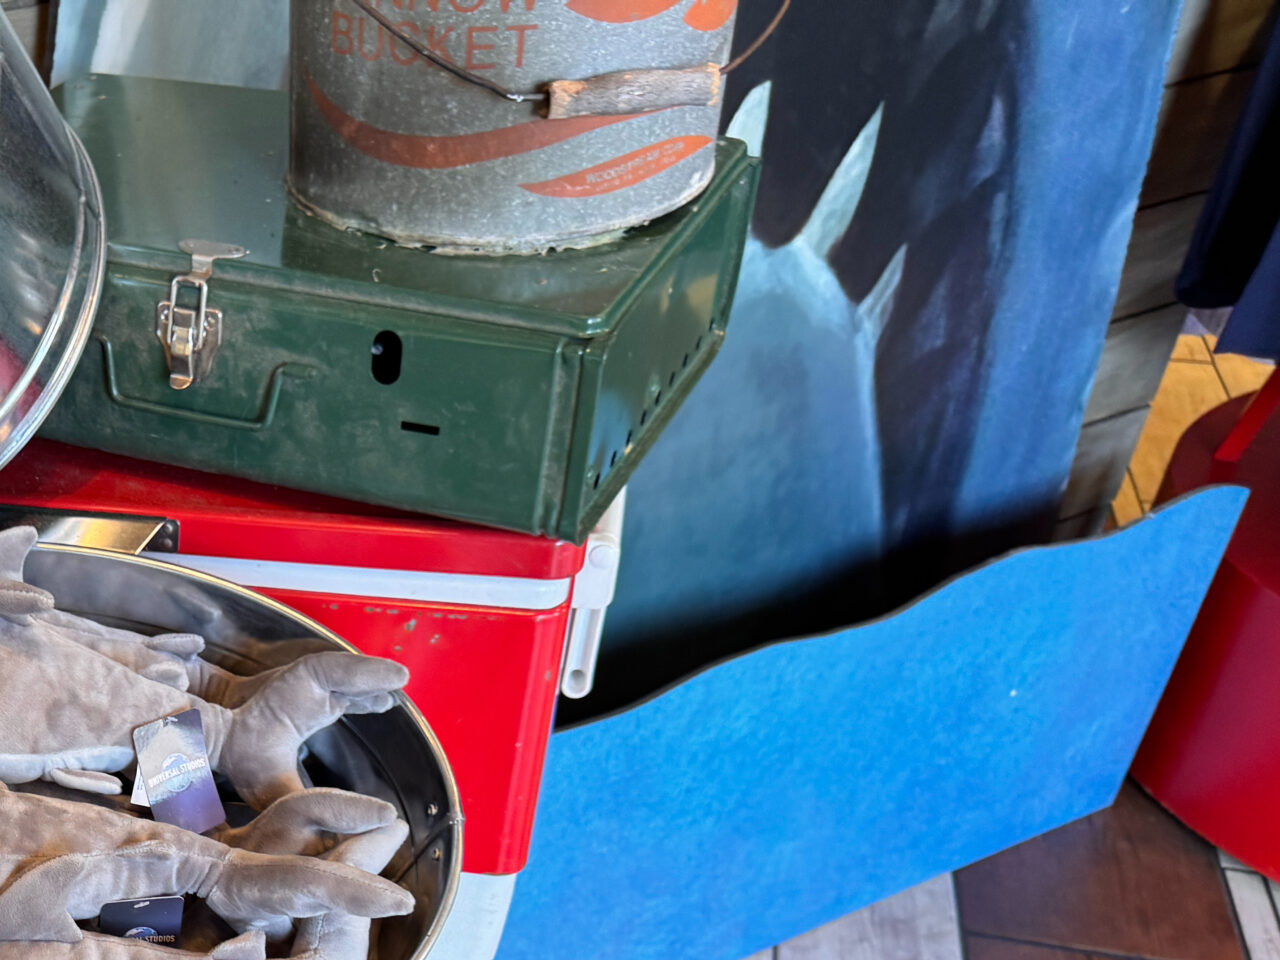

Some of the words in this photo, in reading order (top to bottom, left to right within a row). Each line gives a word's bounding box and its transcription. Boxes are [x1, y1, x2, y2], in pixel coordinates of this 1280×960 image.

[331, 11, 539, 70] BUCKET
[148, 769, 181, 788] UNIVERSAL
[180, 758, 206, 773] STUDIOS
